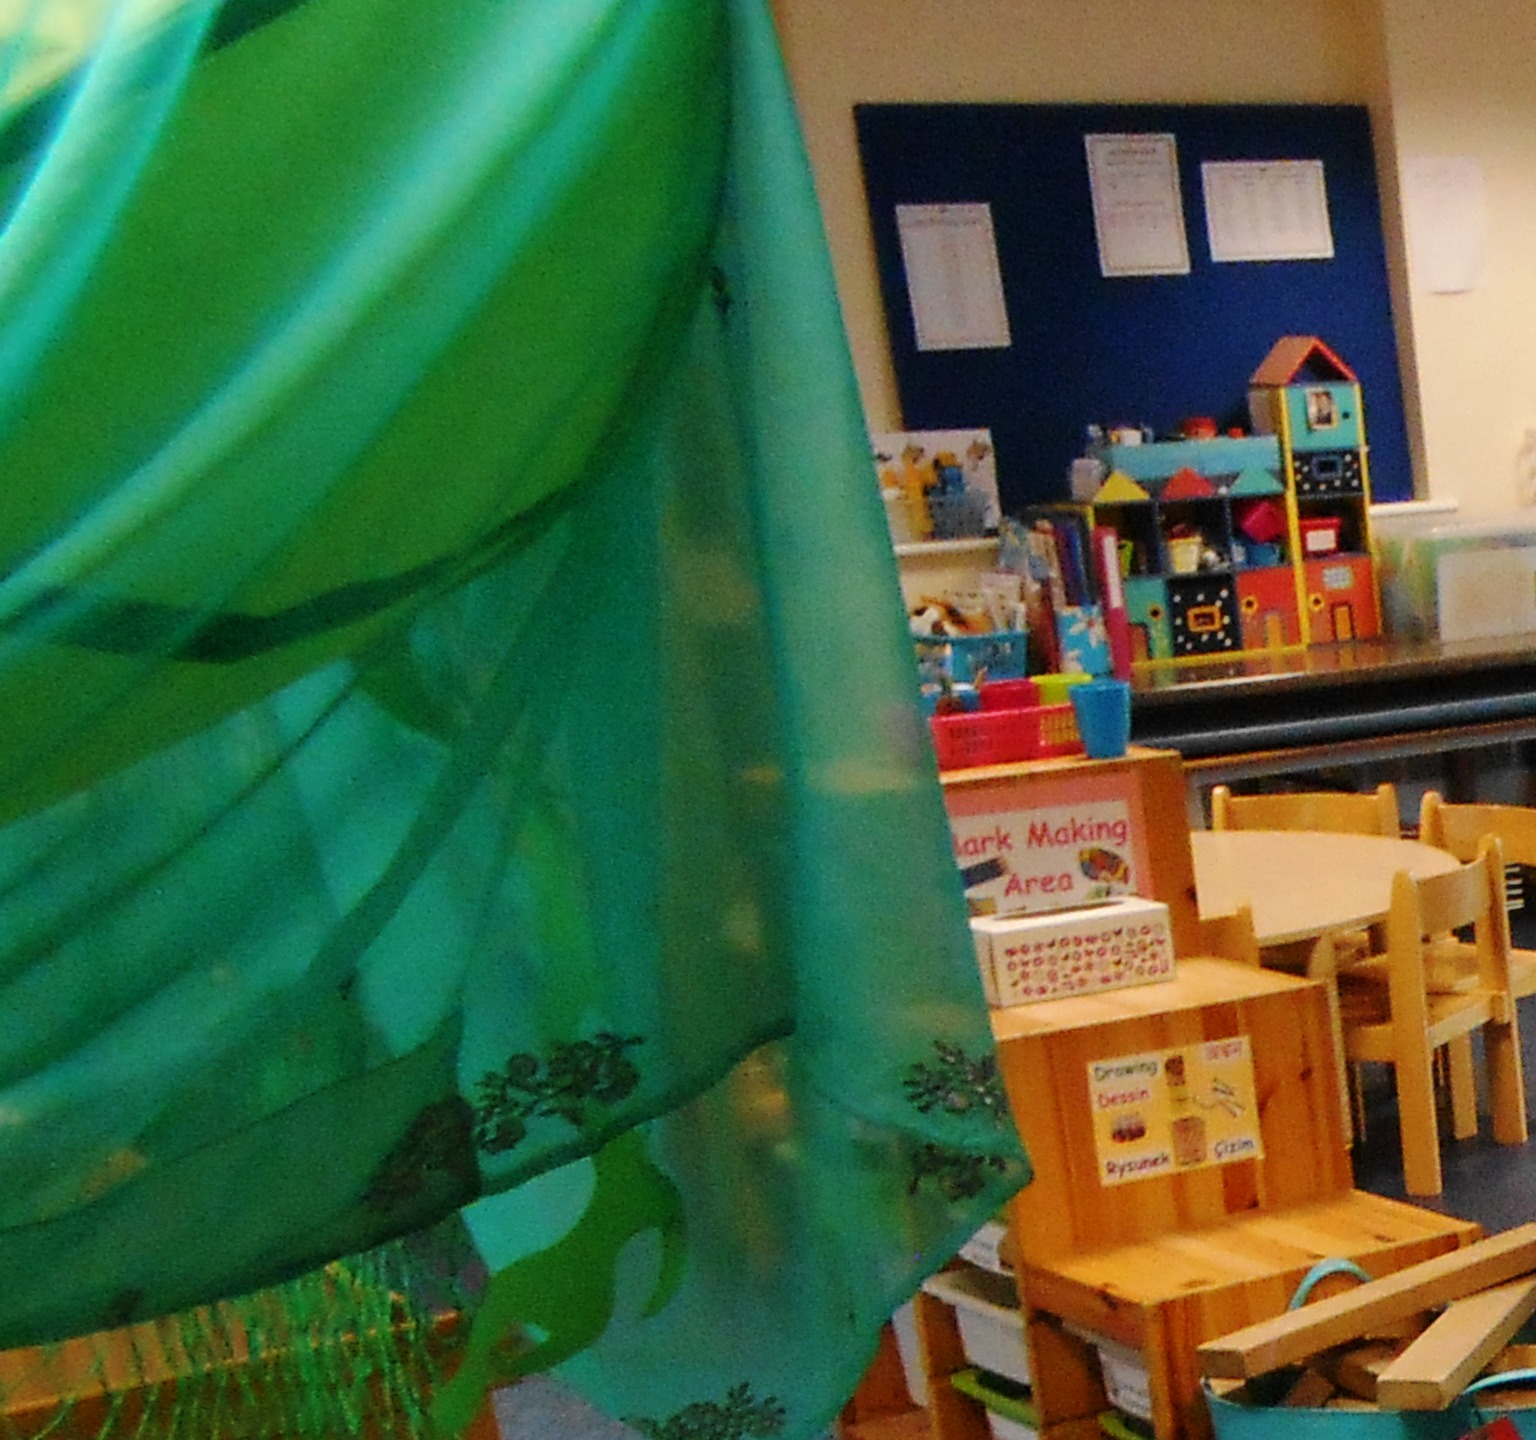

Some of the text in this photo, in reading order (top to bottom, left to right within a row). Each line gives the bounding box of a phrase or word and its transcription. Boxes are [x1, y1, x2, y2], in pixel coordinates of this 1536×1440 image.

[1027, 818, 1128, 847] Making
[1004, 872, 1074, 897] Area
[1093, 1060, 1159, 1083] Drawing
[1098, 1088, 1151, 1109] Dessin
[1106, 1153, 1171, 1178] Rysunek
